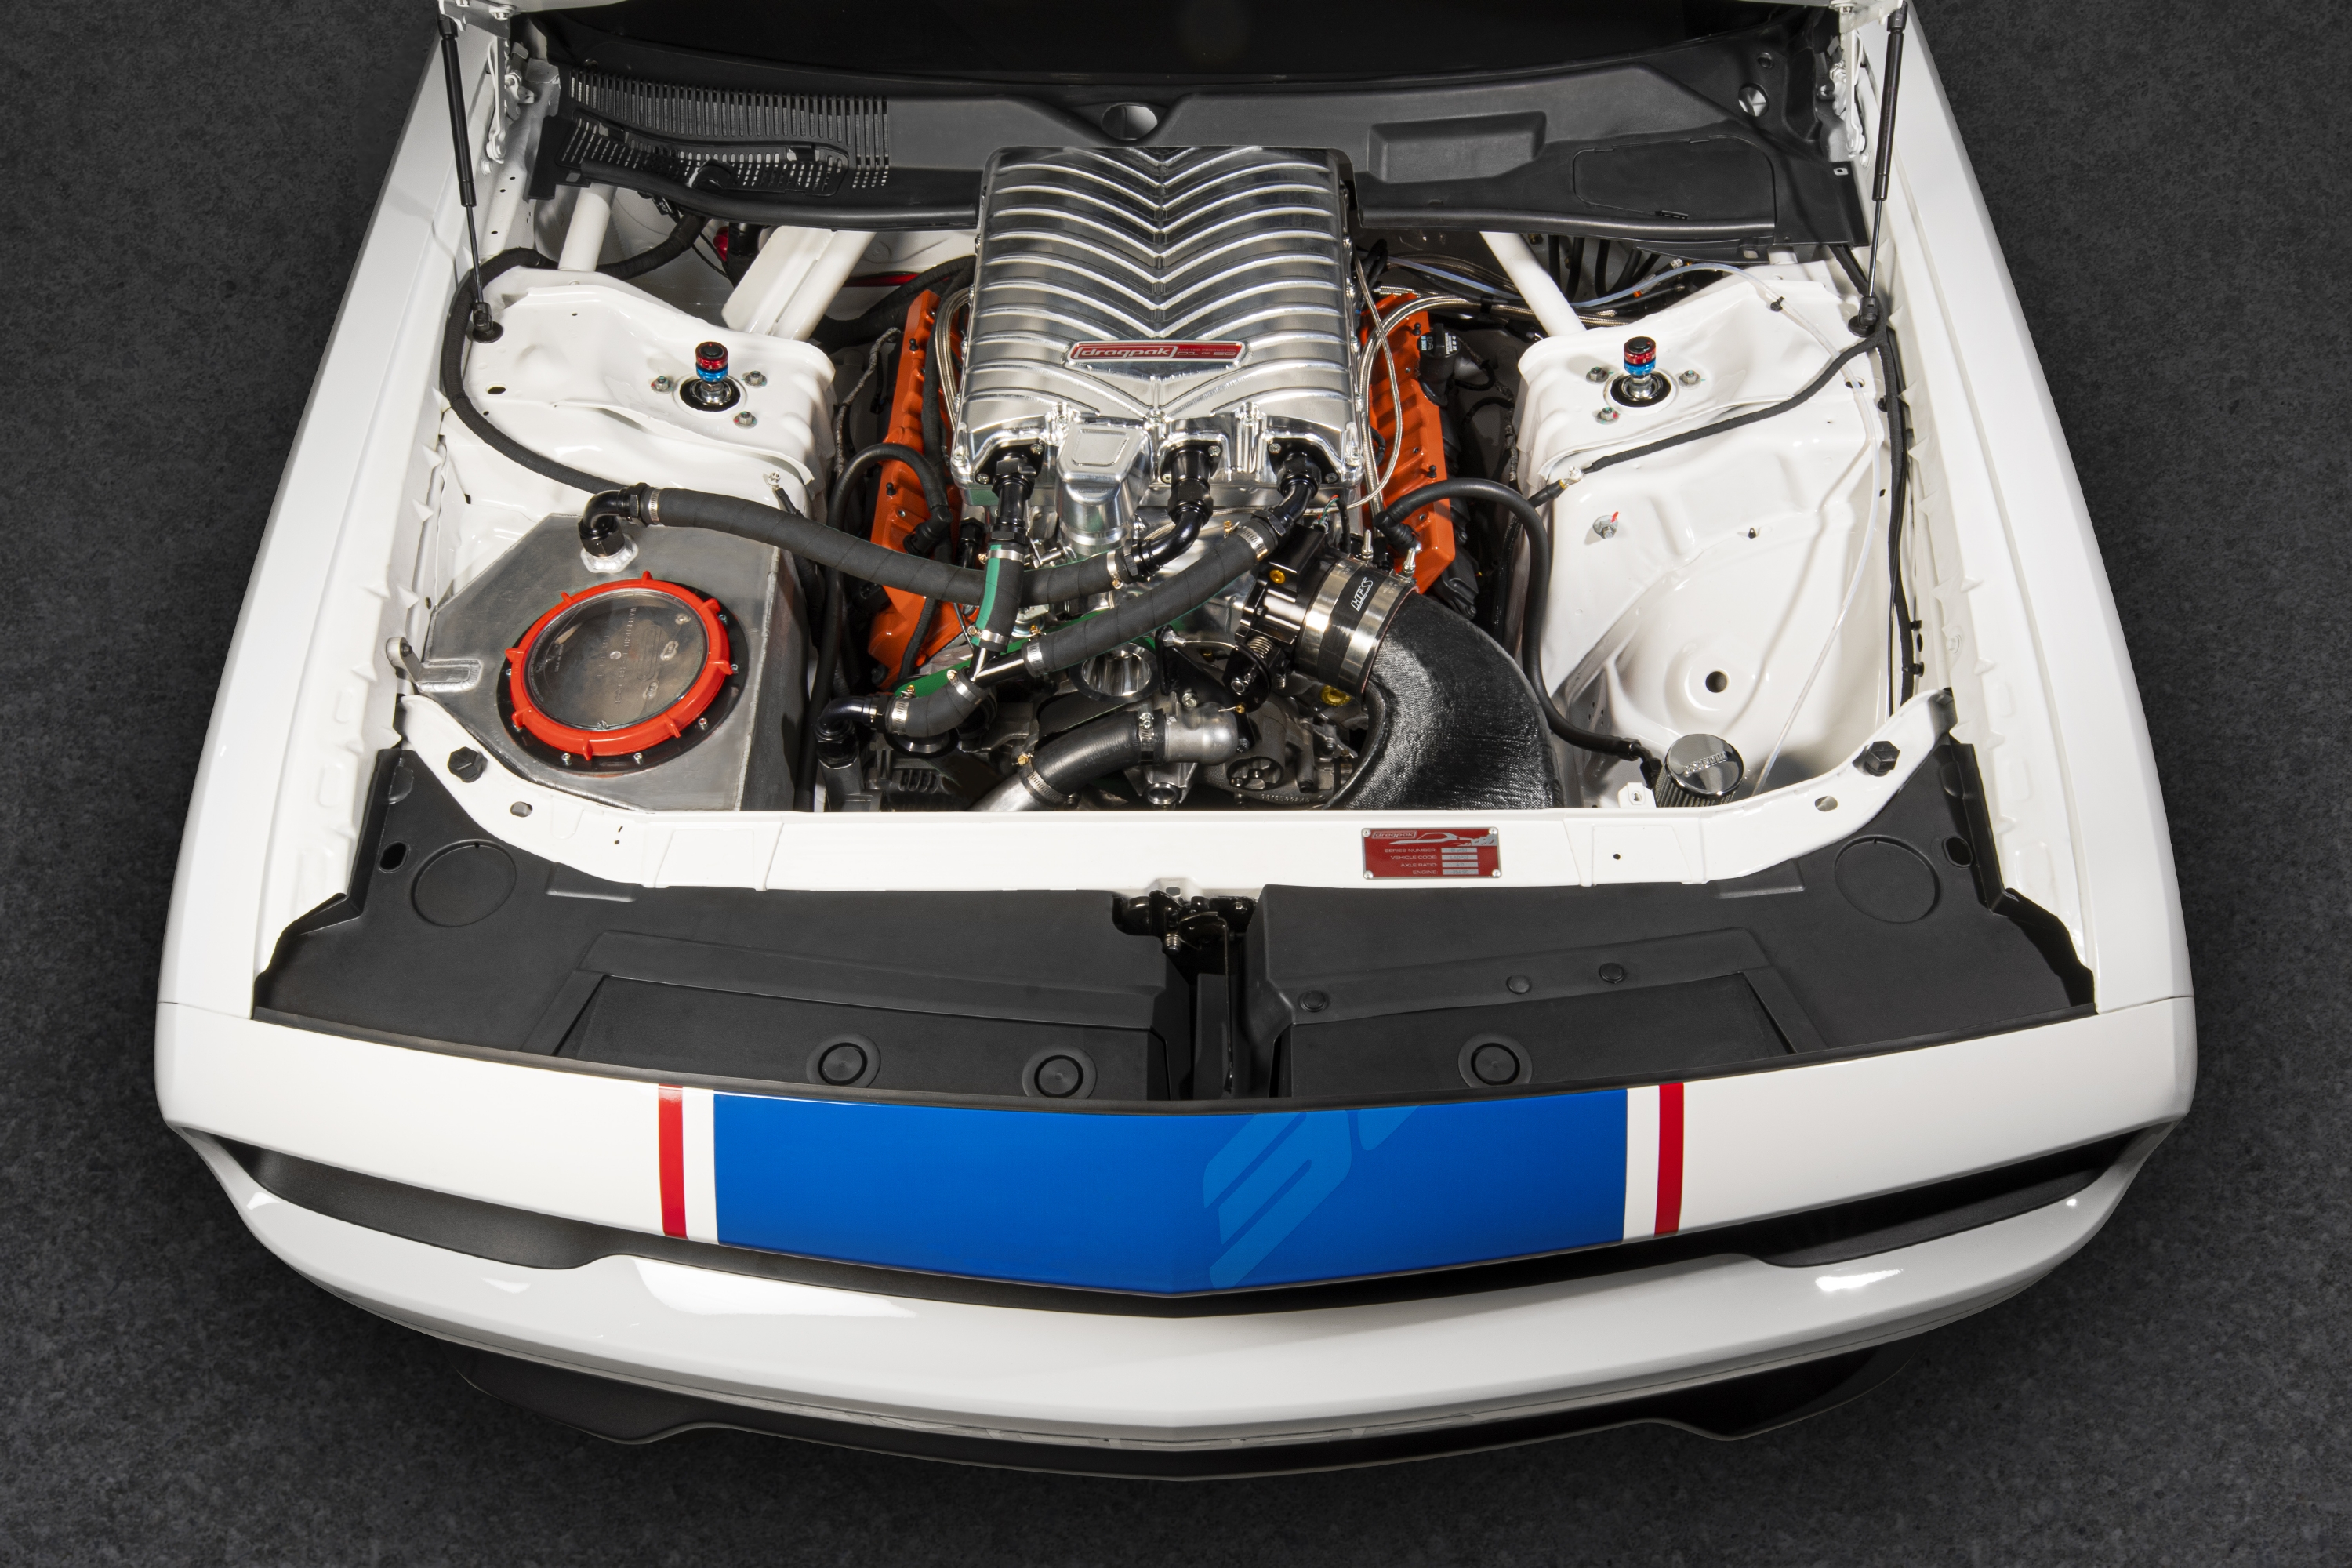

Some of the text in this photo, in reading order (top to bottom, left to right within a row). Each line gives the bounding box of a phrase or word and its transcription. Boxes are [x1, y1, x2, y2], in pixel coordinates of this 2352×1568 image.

[1081, 347, 1171, 358] dragpak
[1350, 576, 1374, 612] HPS
[1087, 750, 1109, 764] MADE
